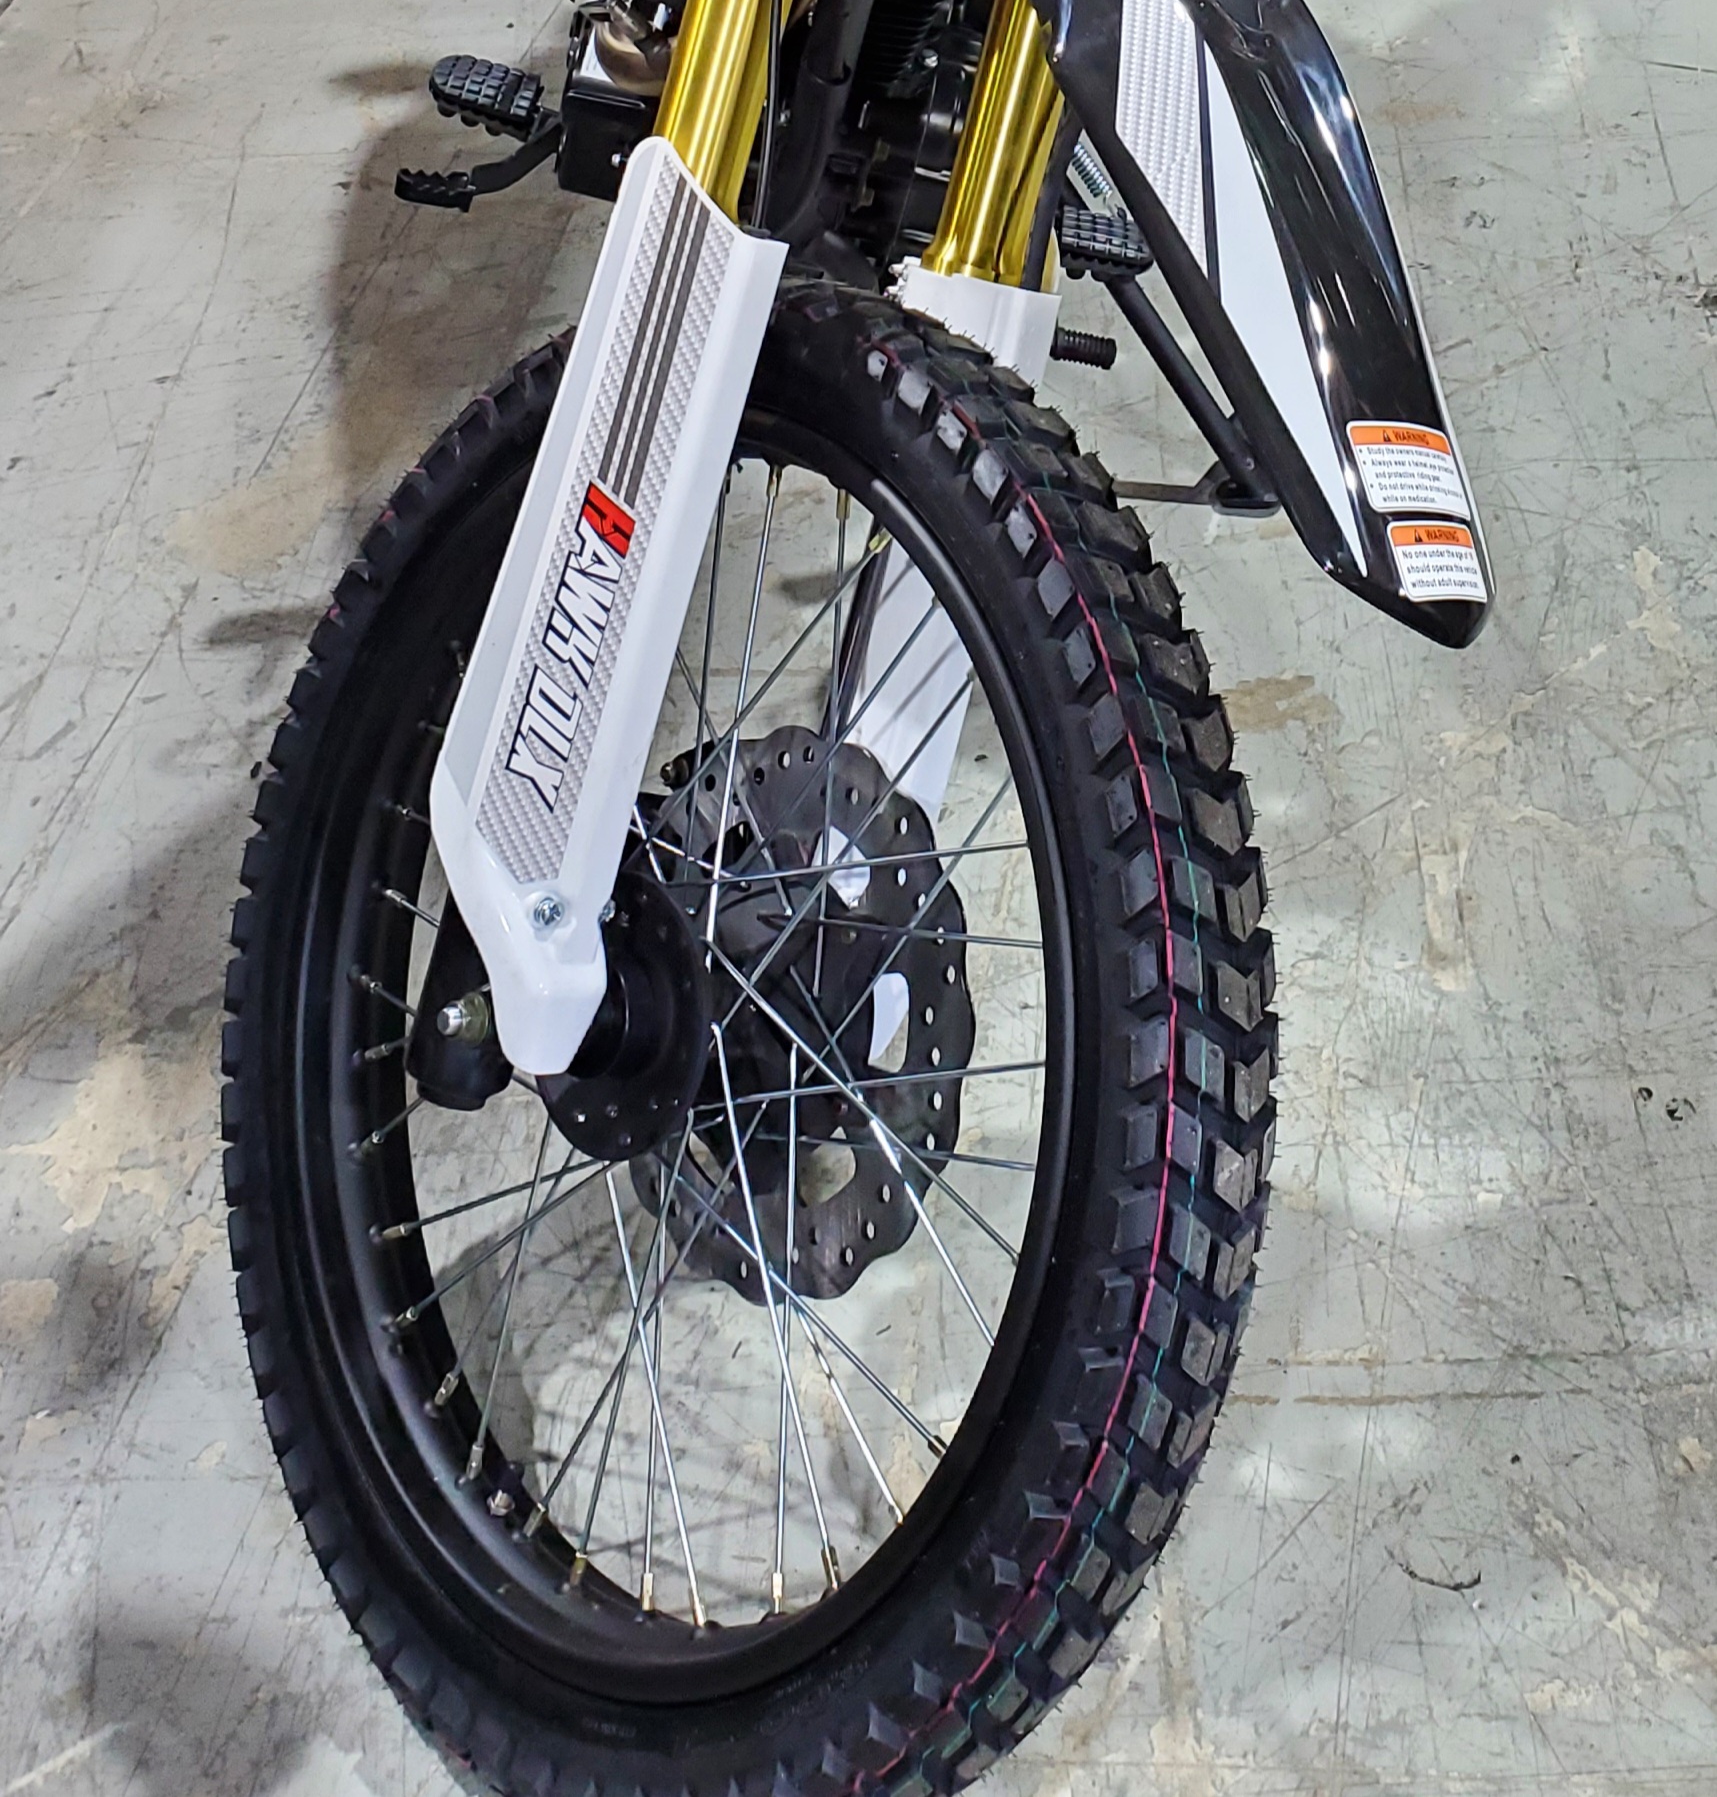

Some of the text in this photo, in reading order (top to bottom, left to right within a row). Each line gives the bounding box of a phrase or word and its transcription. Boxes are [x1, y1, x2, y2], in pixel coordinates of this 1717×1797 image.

[1392, 429, 1430, 446] WARNING
[1425, 529, 1459, 542] WARNING
[1402, 550, 1412, 559] No
[1407, 563, 1430, 574] should
[505, 480, 635, 815] HAWK DLX
